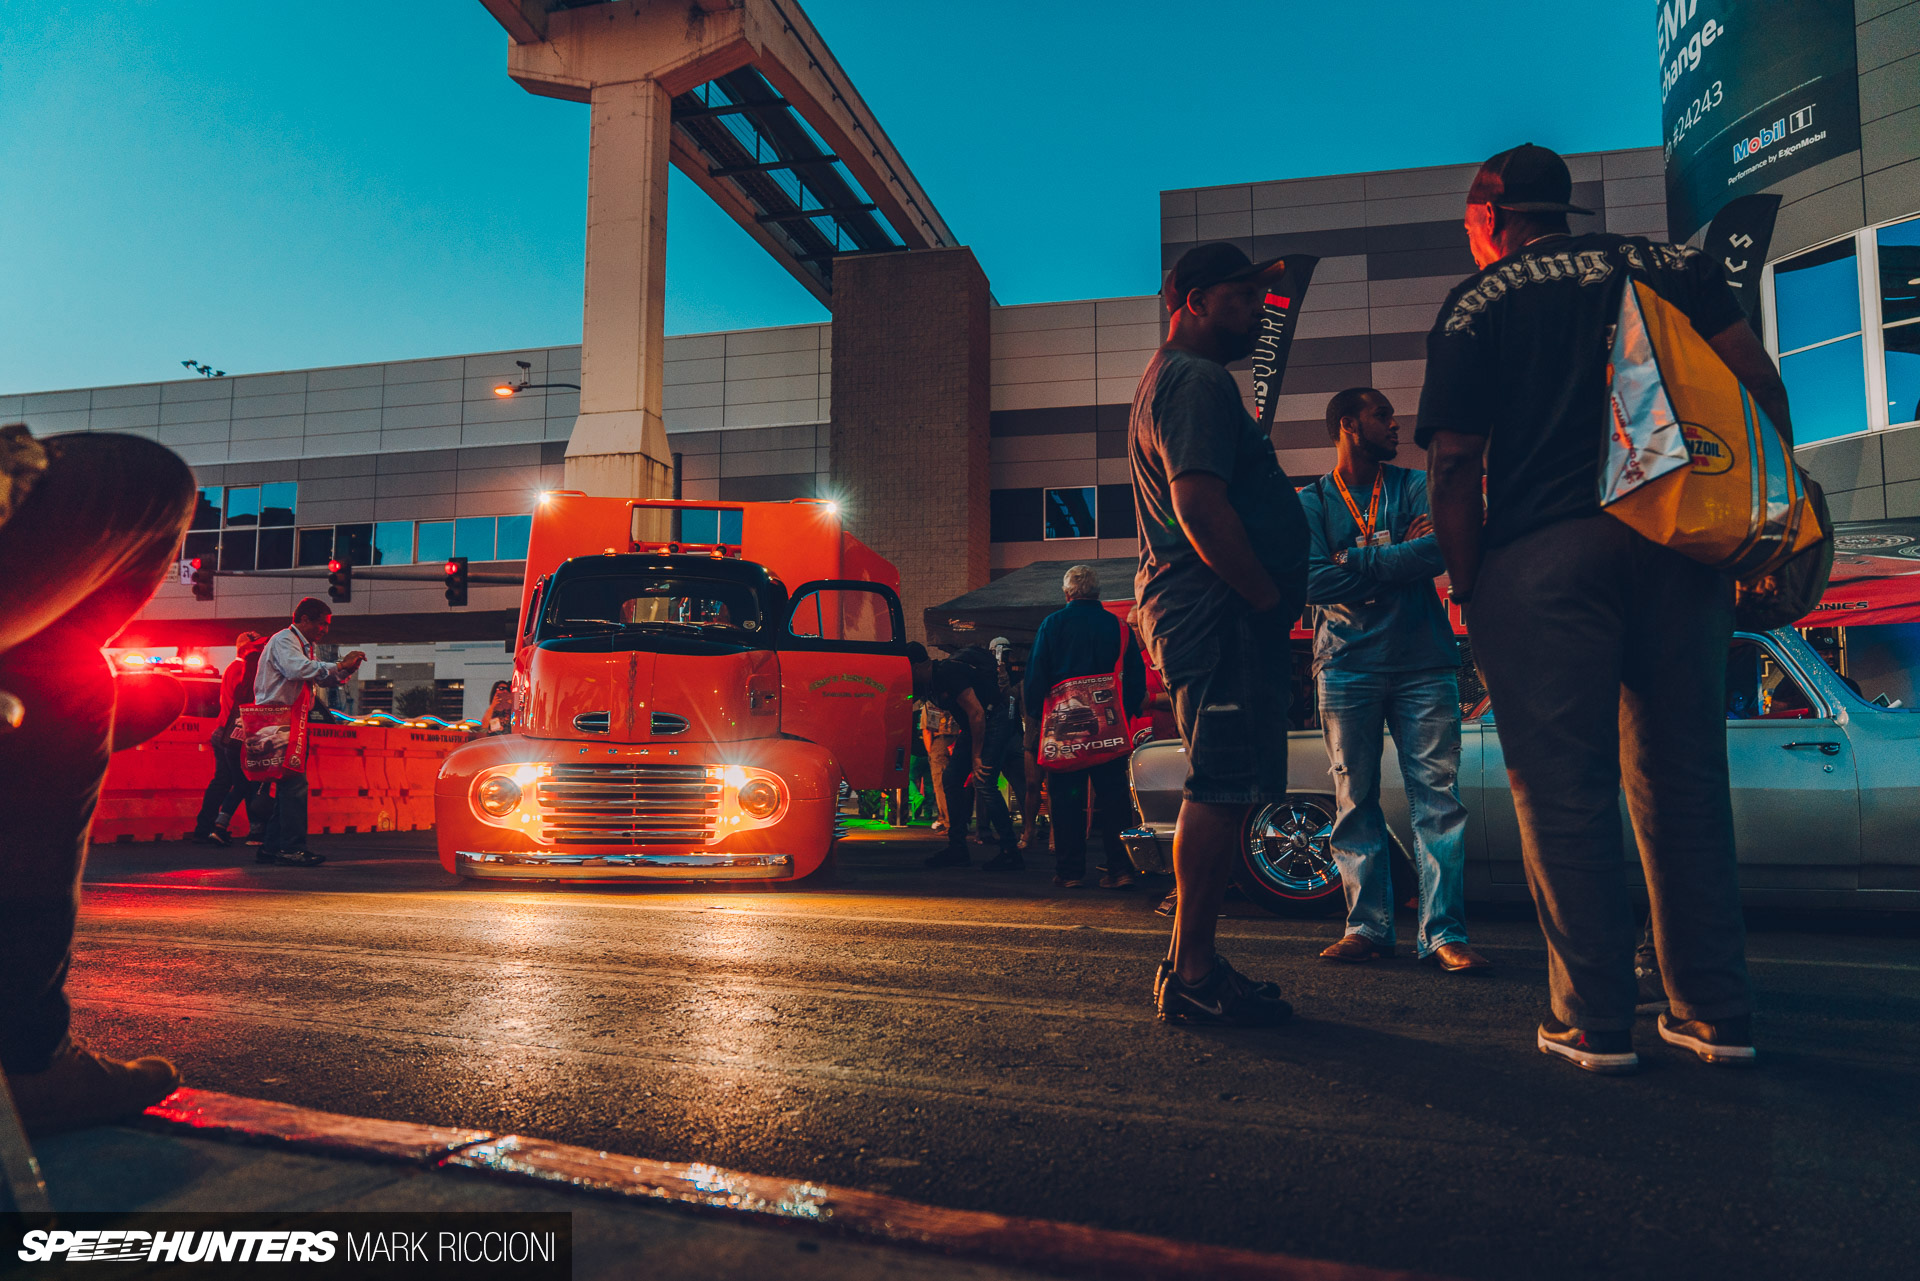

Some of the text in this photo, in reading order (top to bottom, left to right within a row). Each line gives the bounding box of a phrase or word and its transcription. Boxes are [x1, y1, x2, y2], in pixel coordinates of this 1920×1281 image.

[1657, 0, 1697, 69] EM
[1673, 80, 1723, 148] #24243
[1733, 118, 1786, 164] Mobil
[1728, 130, 1826, 186] Performance by ExxonMobil
[1060, 737, 1125, 754] SPYDER
